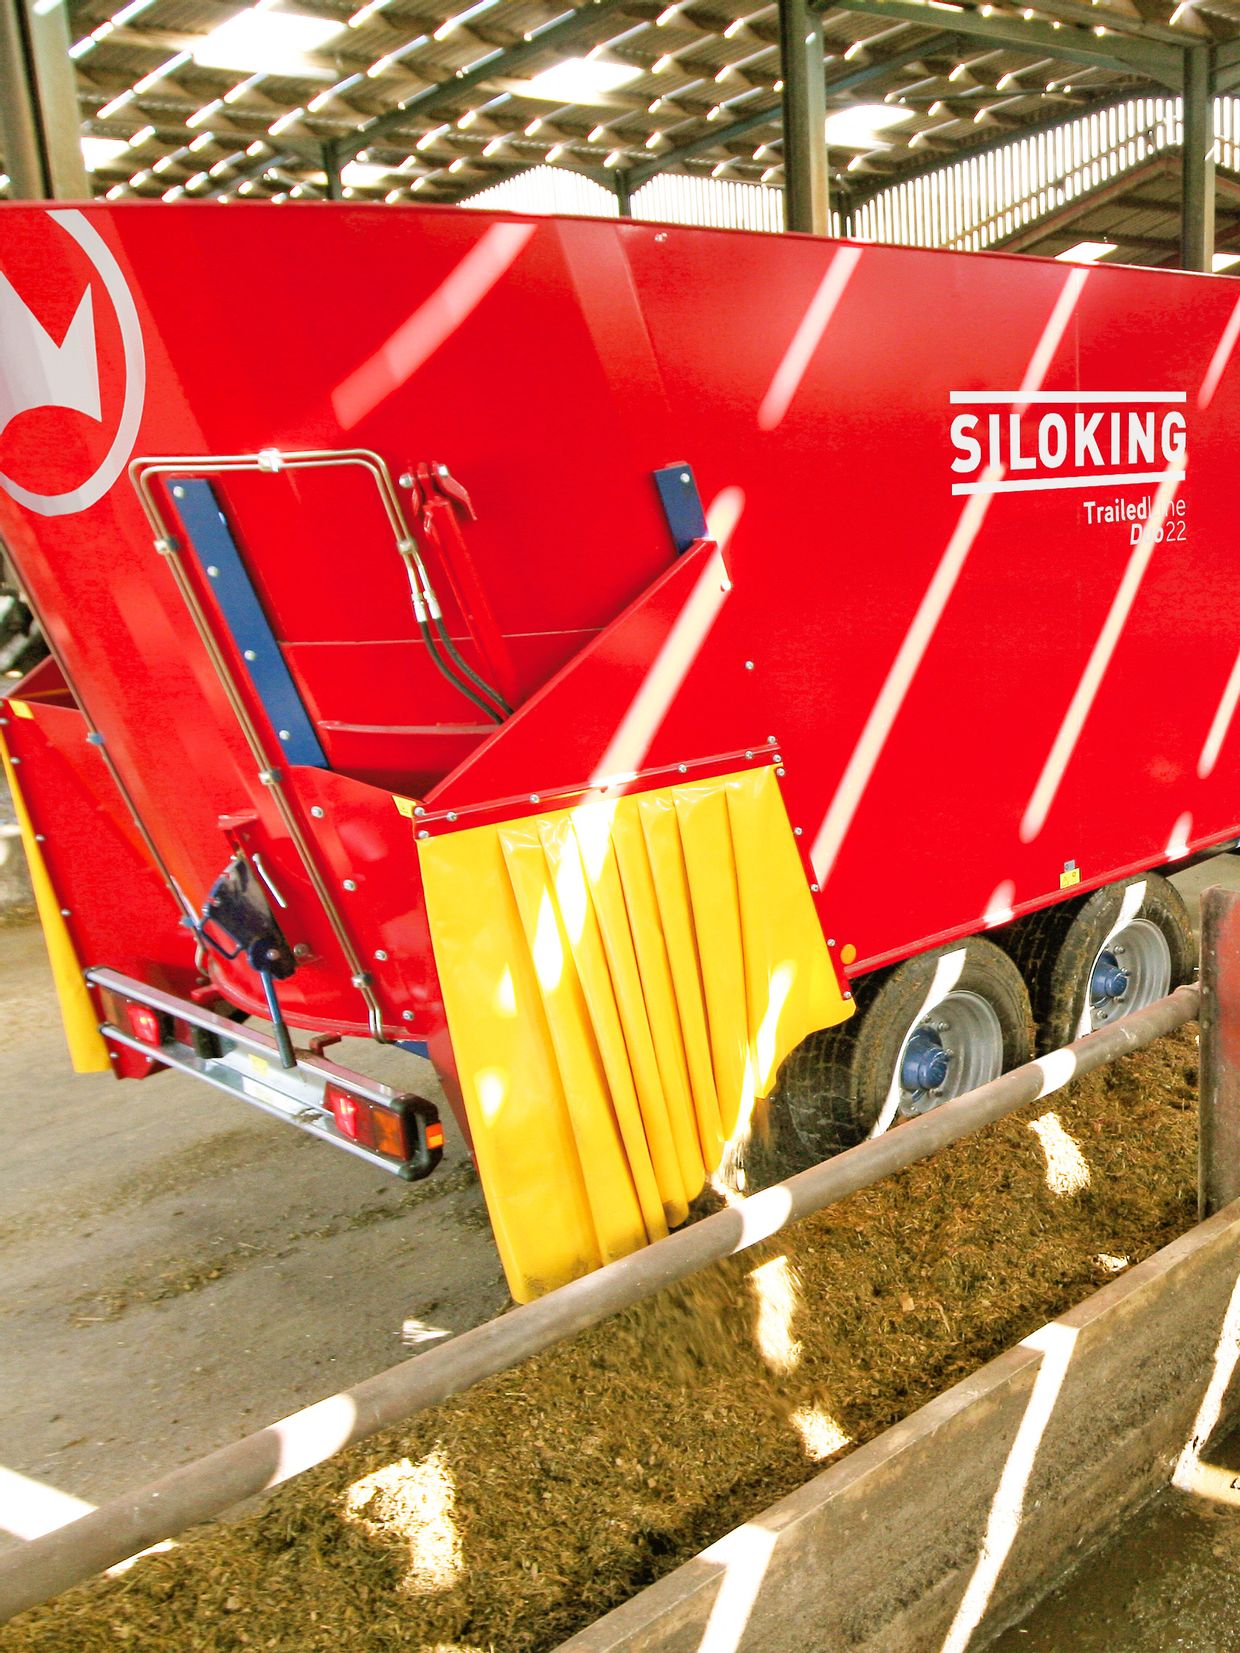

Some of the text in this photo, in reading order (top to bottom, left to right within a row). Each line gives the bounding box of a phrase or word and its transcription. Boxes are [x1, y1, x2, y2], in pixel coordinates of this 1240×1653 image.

[950, 411, 1187, 474] SILOKING
[1083, 495, 1187, 525] TrailedLne
[1129, 520, 1187, 546] Do22
